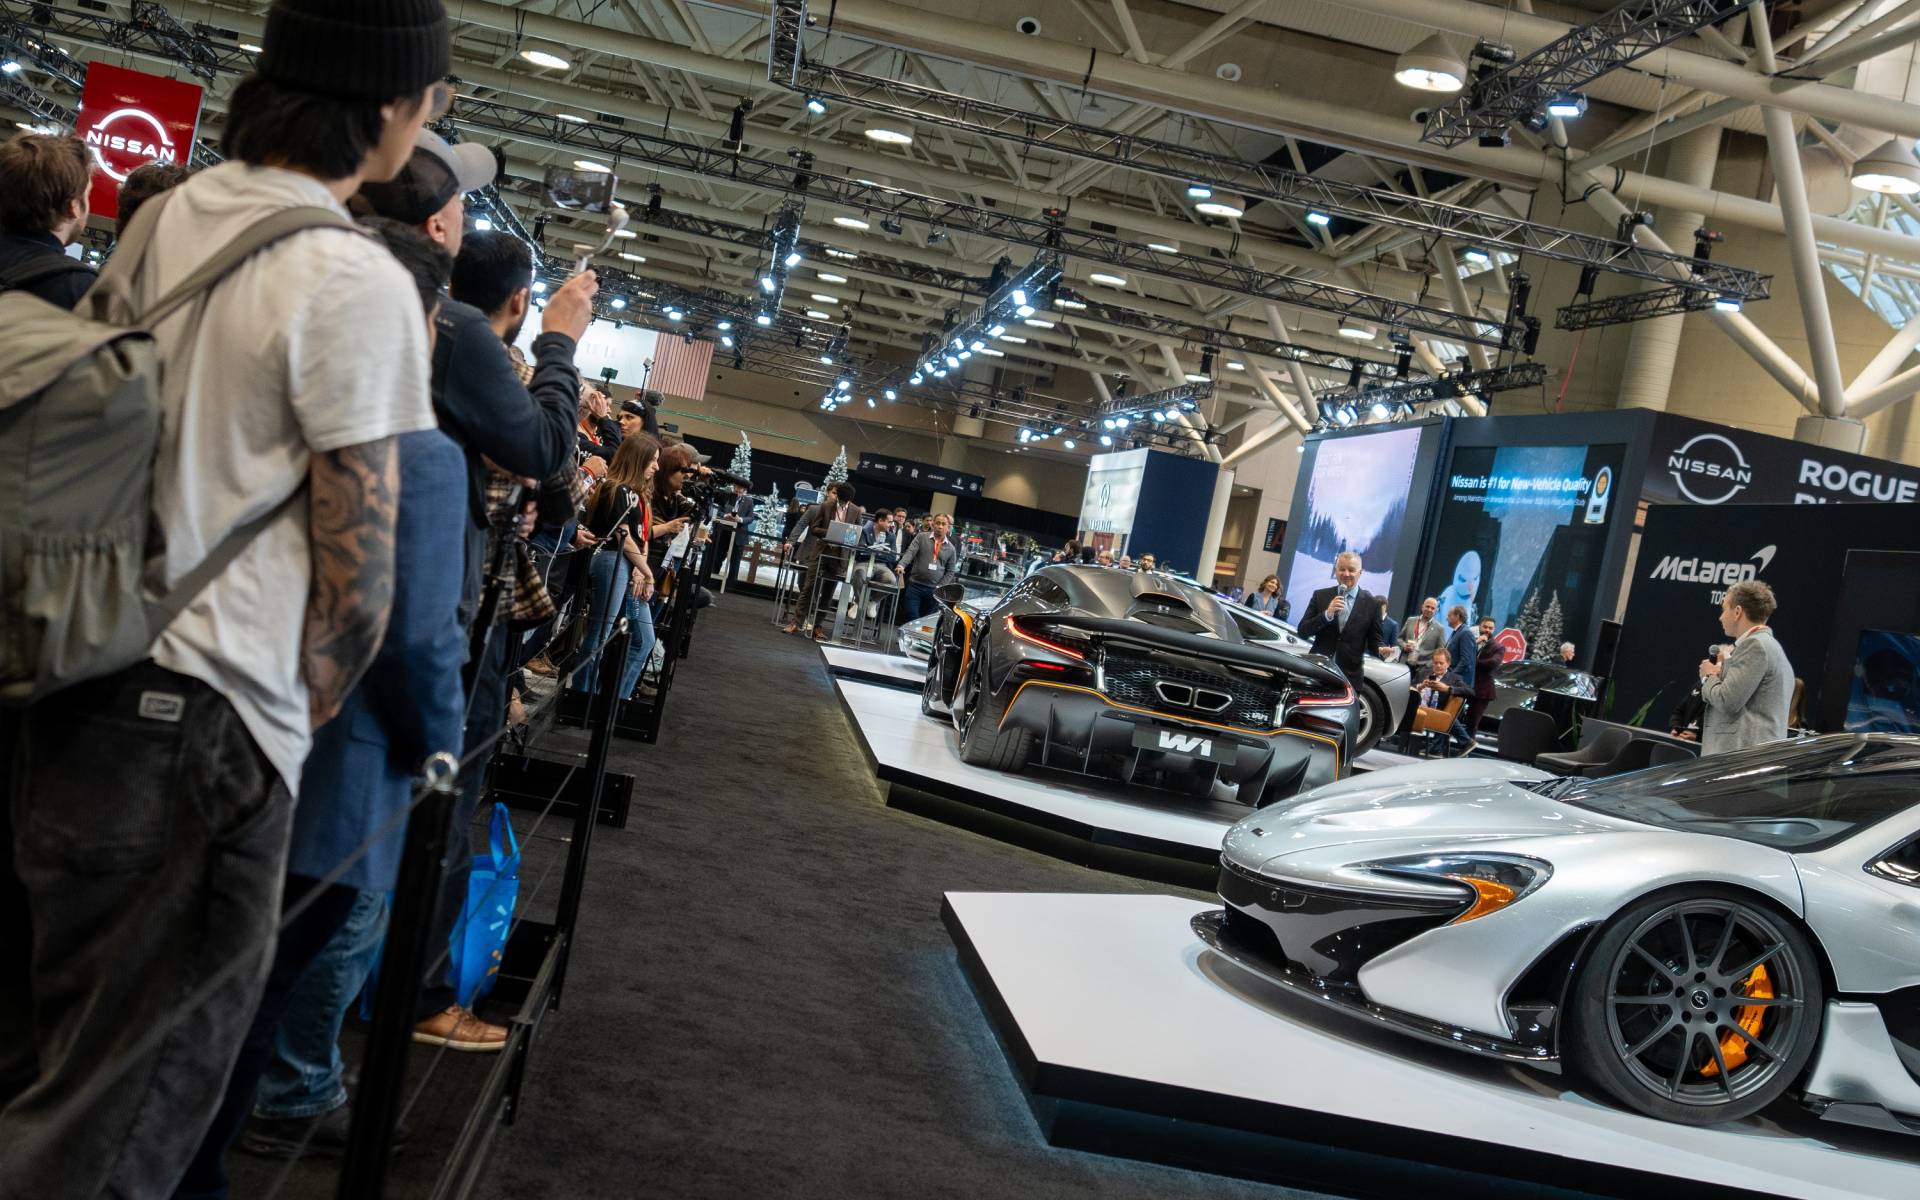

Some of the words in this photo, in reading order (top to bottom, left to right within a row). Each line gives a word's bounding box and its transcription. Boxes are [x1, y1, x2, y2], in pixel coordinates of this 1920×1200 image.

[87, 130, 175, 162] NISSAN
[1668, 455, 1752, 484] NISSAN
[1799, 458, 1919, 503] ROGUE
[1452, 475, 1478, 489] Nissan
[1479, 475, 1487, 489] is
[1488, 476, 1497, 489] #1
[1498, 476, 1511, 490] for
[1511, 476, 1561, 491] New-Vehicle
[1562, 477, 1592, 494] Quality
[1650, 555, 1757, 585] McLaren
[1159, 730, 1212, 757] W1
